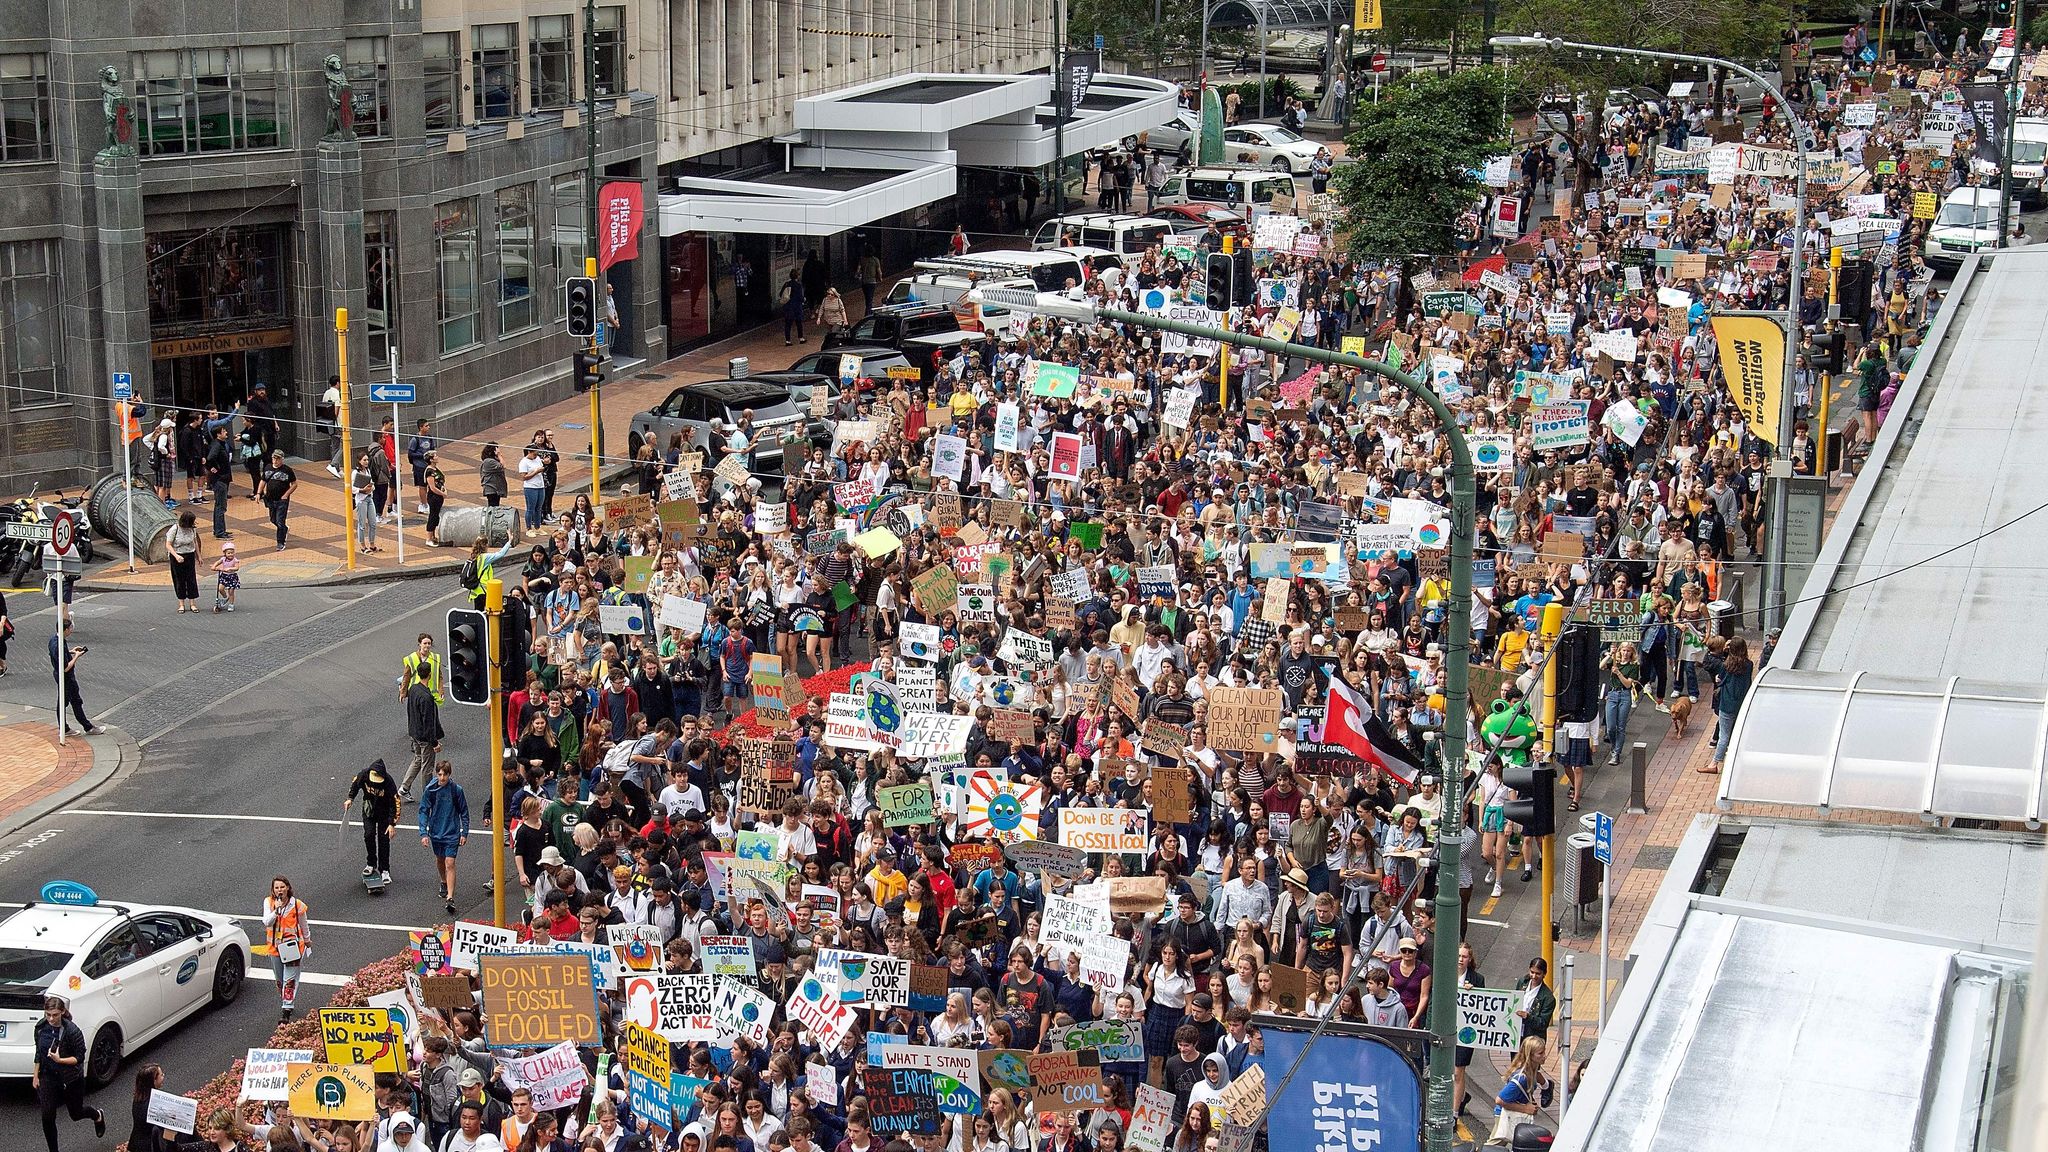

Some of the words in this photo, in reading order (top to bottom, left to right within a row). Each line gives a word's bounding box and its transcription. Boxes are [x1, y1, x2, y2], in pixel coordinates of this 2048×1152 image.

[1924, 113, 1940, 121] SAVE
[1924, 121, 1955, 132] WORLD
[1612, 155, 1624, 164] WE
[620, 198, 631, 222] Piki
[1861, 220, 1875, 228] SEA
[1876, 221, 1900, 229] LEVELS
[1307, 235, 1320, 243] LIVE
[1286, 279, 1298, 288] NO
[1484, 270, 1497, 279] GIVE
[1499, 276, 1508, 284] US
[1262, 298, 1286, 307] PLANET
[1424, 295, 1449, 304] Save
[1427, 302, 1453, 310] earth
[1169, 307, 1210, 321] CLEAN
[157, 345, 174, 355] 143
[180, 339, 231, 352] LAMBTON
[237, 335, 265, 347] QUAY
[118, 374, 126, 382] P
[1176, 390, 1189, 399] OUR
[1535, 417, 1588, 433] PROTECT
[668, 477, 690, 486] CLIMATE
[848, 489, 862, 498] SAVE
[863, 487, 876, 496] THE
[937, 494, 959, 506] STOP
[937, 506, 960, 515] GLOBAL
[12, 525, 37, 537] STOUT
[39, 528, 49, 538] ST
[57, 524, 70, 544] 50
[812, 533, 830, 542] STOP
[958, 546, 978, 558] OUR
[1419, 550, 1446, 558] STOP
[1478, 561, 1494, 570] ICE
[1051, 574, 1070, 582] ROSES
[959, 587, 978, 597] SAVE
[978, 588, 993, 597] OUR
[1140, 584, 1171, 594] DROWN
[1591, 601, 1633, 613] ZERO
[960, 610, 993, 621] PLANET
[901, 630, 923, 640] RUNNING
[924, 633, 935, 641] OUT
[927, 646, 938, 655] TIME
[1012, 636, 1037, 650] THIS
[1039, 642, 1051, 652] IS
[1008, 663, 1025, 671] ONE
[1035, 660, 1055, 672] EARTH
[898, 678, 935, 686] PLANET
[756, 683, 783, 698] NOT
[900, 688, 935, 699] GREAT
[1212, 690, 1254, 705] CLEAN
[1259, 691, 1277, 705] UP
[831, 695, 849, 705] WE'RE
[756, 706, 790, 722] DISASTERS
[1211, 707, 1233, 721] OUR
[1298, 708, 1311, 716] WE
[1312, 707, 1324, 716] ARE
[827, 723, 855, 737] TEACH
[909, 716, 961, 731] WE'RE
[1210, 722, 1231, 735] IT'S
[1234, 723, 1260, 739] NOT
[868, 728, 891, 746] WAKE
[891, 735, 902, 748] UP
[1296, 743, 1316, 752] WHICH
[1319, 744, 1326, 752] IS
[939, 753, 964, 763] PLANET
[891, 787, 925, 809] FOR
[1159, 788, 1176, 799] NO
[1100, 811, 1115, 826] BE
[1119, 813, 1129, 825] A
[1000, 832, 1021, 841] HERE
[1067, 831, 1117, 850] FOSSIL
[1119, 834, 1148, 849] FOOL
[53, 891, 65, 899] 384
[66, 892, 82, 900] 4444
[1054, 898, 1081, 913] TREAT
[1081, 906, 1099, 917] THE
[1046, 908, 1076, 921] PLANET
[1076, 915, 1093, 927] LIKE
[1064, 921, 1093, 932] EARTH
[483, 932, 508, 946] OUR
[701, 936, 731, 946] RESPECT
[731, 936, 747, 946] OUR
[1047, 930, 1061, 940] NOT
[870, 960, 907, 976] SAVE
[486, 964, 553, 988] DON'T
[563, 965, 589, 986] BE
[657, 976, 686, 988] BACK
[690, 975, 710, 985] THE
[872, 975, 900, 988] OUR
[1086, 968, 1117, 989] WORLD
[659, 986, 711, 1005] ZERO
[723, 975, 748, 999] THERE
[754, 994, 764, 1007] IS
[865, 988, 907, 1004] EARTH
[506, 989, 574, 1012] FOSSIL
[1457, 993, 1508, 1012] RESPECT
[660, 1003, 712, 1016] CARBON
[322, 1012, 356, 1025] THERE
[359, 1012, 376, 1027] IS
[661, 1016, 688, 1030] ACT
[691, 1016, 713, 1030] NZ
[713, 1006, 754, 1034] PLANET
[753, 1024, 764, 1041] B
[790, 996, 840, 1049] FUTURE
[1462, 1011, 1497, 1028] YOUR
[494, 1013, 594, 1042] FOOLED
[326, 1027, 350, 1043] NO
[1066, 1027, 1125, 1050] SAVE
[628, 1026, 668, 1063] CHANGE
[352, 1047, 364, 1064] B
[886, 1052, 918, 1065] WHAT
[924, 1055, 932, 1067] I
[937, 1056, 971, 1068] STAND
[630, 1052, 666, 1083] POLITICS
[1029, 1056, 1078, 1073] GLOBAL
[289, 1068, 313, 1094] THERE
[314, 1064, 323, 1073] IS
[326, 1065, 339, 1073] NO
[341, 1068, 373, 1094] PLANET
[956, 1069, 969, 1083] 4
[1038, 1066, 1098, 1085] WARMING
[631, 1075, 648, 1094] NOT
[651, 1082, 669, 1106] THE
[893, 1072, 935, 1096] EARTH
[1037, 1082, 1066, 1097] NOT
[1221, 1065, 1262, 1104] WITH
[323, 1082, 341, 1105] B
[1063, 1083, 1105, 1105] COOL
[632, 1095, 671, 1127] CLIMATE
[870, 1098, 914, 1116] CLEAN
[872, 1114, 920, 1132] URANUS
[1133, 1104, 1169, 1128] ACT
[1131, 1130, 1162, 1148] Climate
